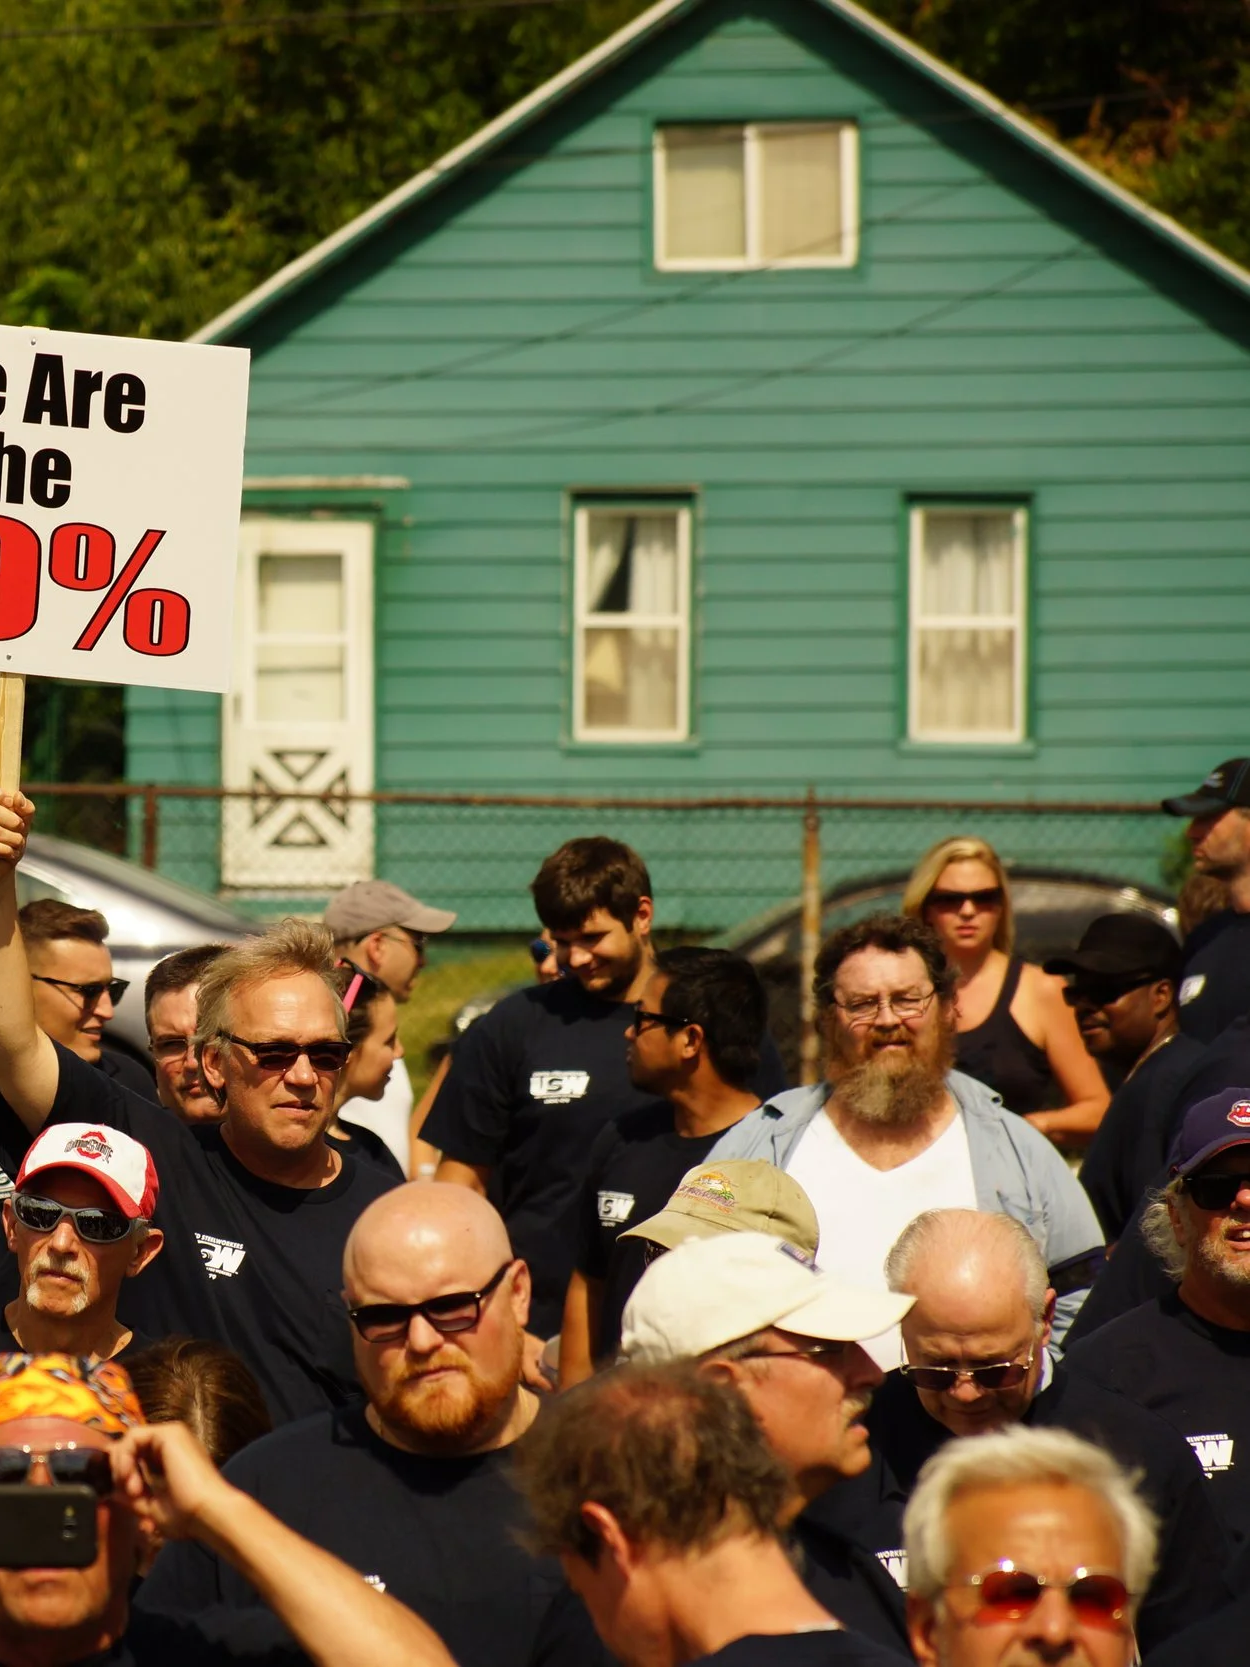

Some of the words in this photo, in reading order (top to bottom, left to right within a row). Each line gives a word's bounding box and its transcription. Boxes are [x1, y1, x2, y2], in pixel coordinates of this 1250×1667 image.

[22, 353, 146, 434] Are
[529, 1075, 590, 1097] USW
[1186, 1434, 1229, 1443] ELWORKERS
